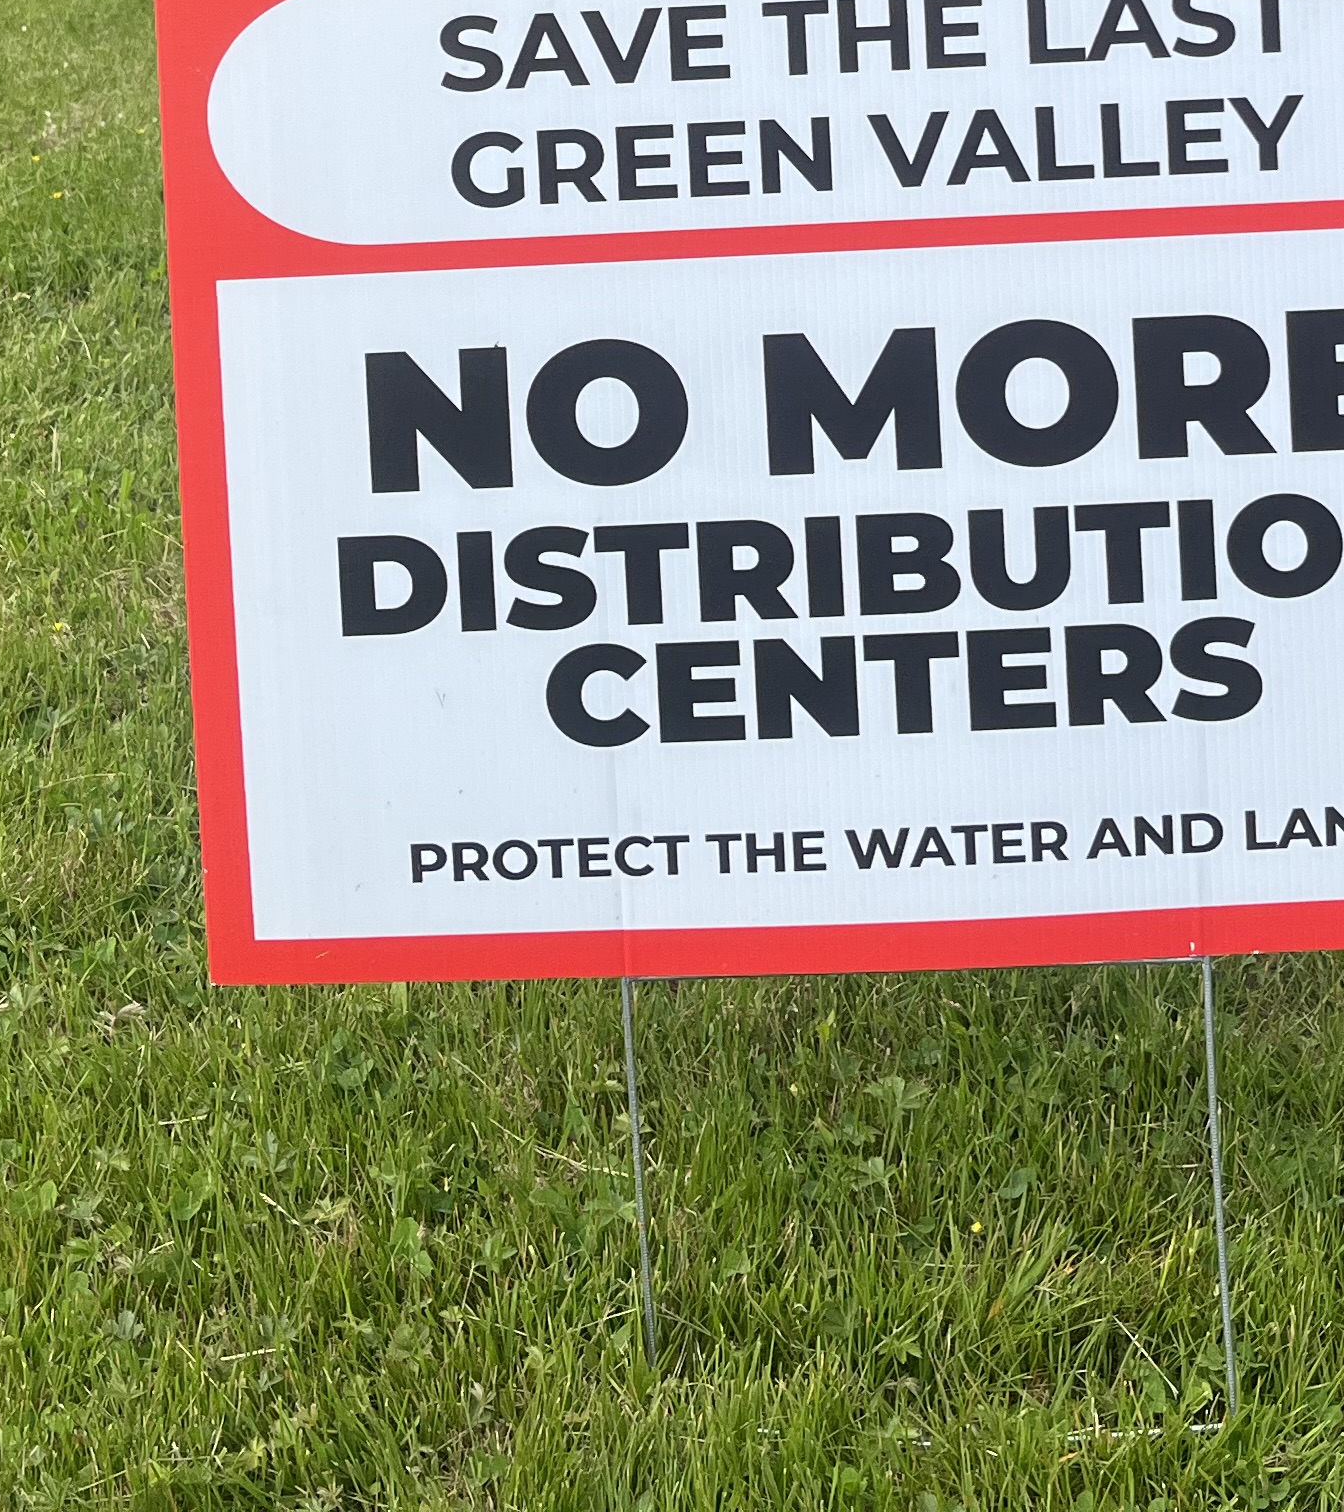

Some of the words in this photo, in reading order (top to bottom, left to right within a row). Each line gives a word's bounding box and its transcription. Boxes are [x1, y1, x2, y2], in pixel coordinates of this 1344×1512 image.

[440, 4, 731, 93] SAVE
[451, 116, 833, 209] GREEN
[866, 94, 1304, 188] VALLEY
[364, 338, 689, 494] NO
[545, 616, 1263, 748] CENTERS
[410, 834, 690, 884] PROTECT
[705, 830, 827, 874] THE
[844, 822, 1069, 870] WATER
[1086, 812, 1224, 860] AND
